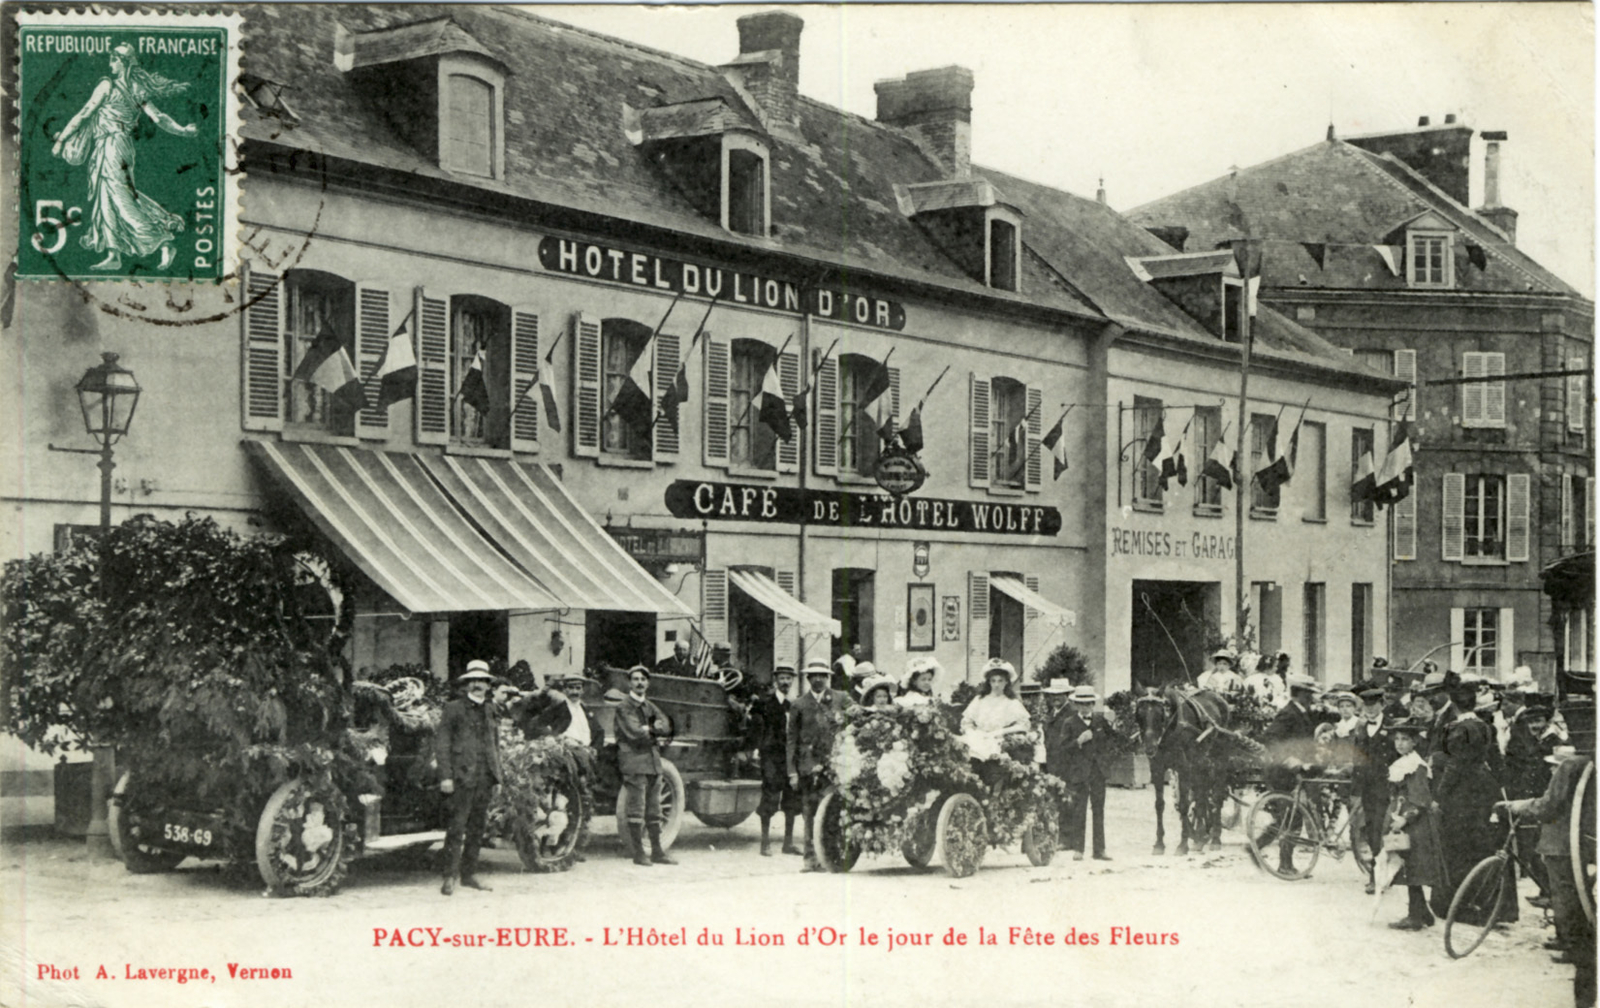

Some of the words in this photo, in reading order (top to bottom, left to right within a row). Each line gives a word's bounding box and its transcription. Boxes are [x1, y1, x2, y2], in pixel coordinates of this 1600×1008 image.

[26, 35, 112, 57] REPUBLIQUE
[139, 36, 218, 57] FRANÇAISE
[194, 186, 215, 268] POSTES
[558, 240, 670, 288] HOTEL
[682, 263, 722, 296] DU
[734, 273, 799, 310] LION
[818, 290, 890, 327] D'OR
[693, 482, 778, 518] CAFÉ
[813, 500, 840, 521] DE
[971, 504, 1044, 531] WOLFF
[1111, 526, 1172, 557] REMISES
[1174, 540, 1187, 557] ET
[1191, 531, 1238, 560] GARAG
[164, 823, 213, 846] 538-G9
